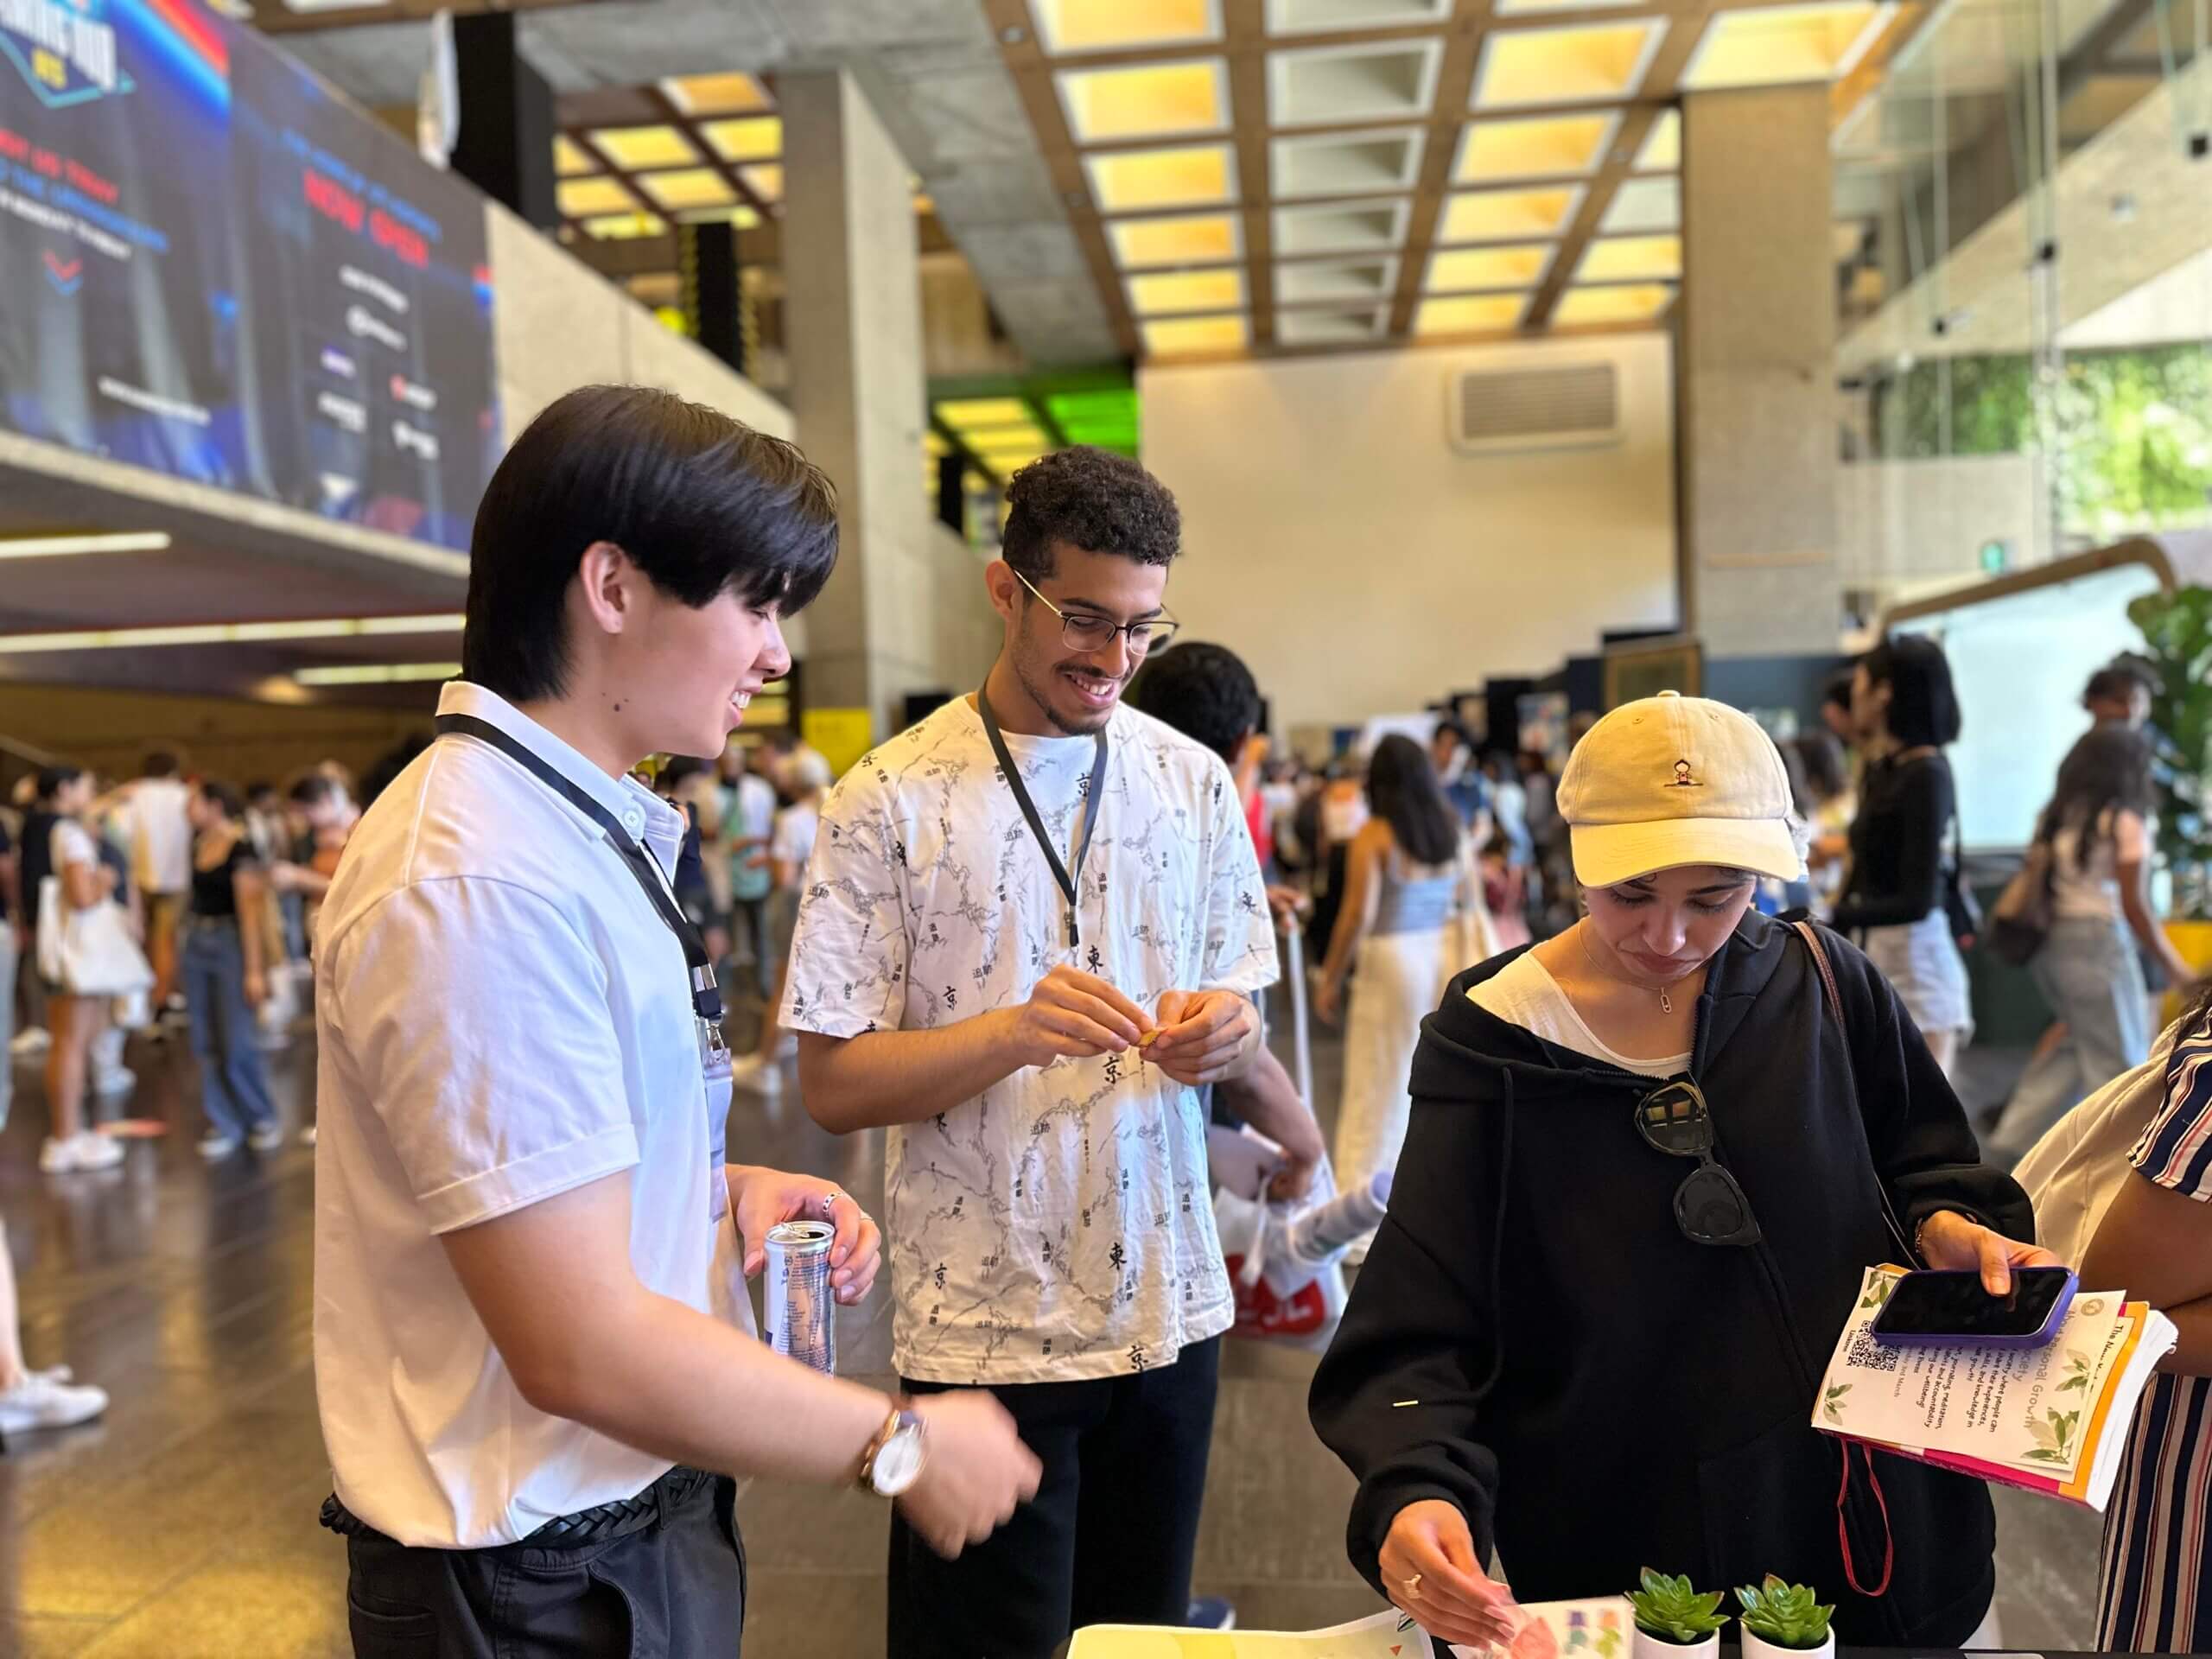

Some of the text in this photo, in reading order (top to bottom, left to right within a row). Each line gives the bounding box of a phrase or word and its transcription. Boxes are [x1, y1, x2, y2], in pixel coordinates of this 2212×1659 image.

[1087, 945, 1103, 974] 東
[1103, 1056, 1122, 1084] 京
[1109, 1243, 1127, 1270] 東
[934, 1262, 947, 1289] 京
[1127, 1344, 1148, 1371] 京
[2012, 1348, 2031, 1382] ociety
[1977, 1370, 1986, 1384] and
[1923, 1380, 1942, 1428] accountability
[1966, 1384, 1984, 1420] knowledge
[1991, 1395, 2003, 1419] people
[2023, 1384, 2044, 1429] Growth
[1989, 1420, 1998, 1433] can
